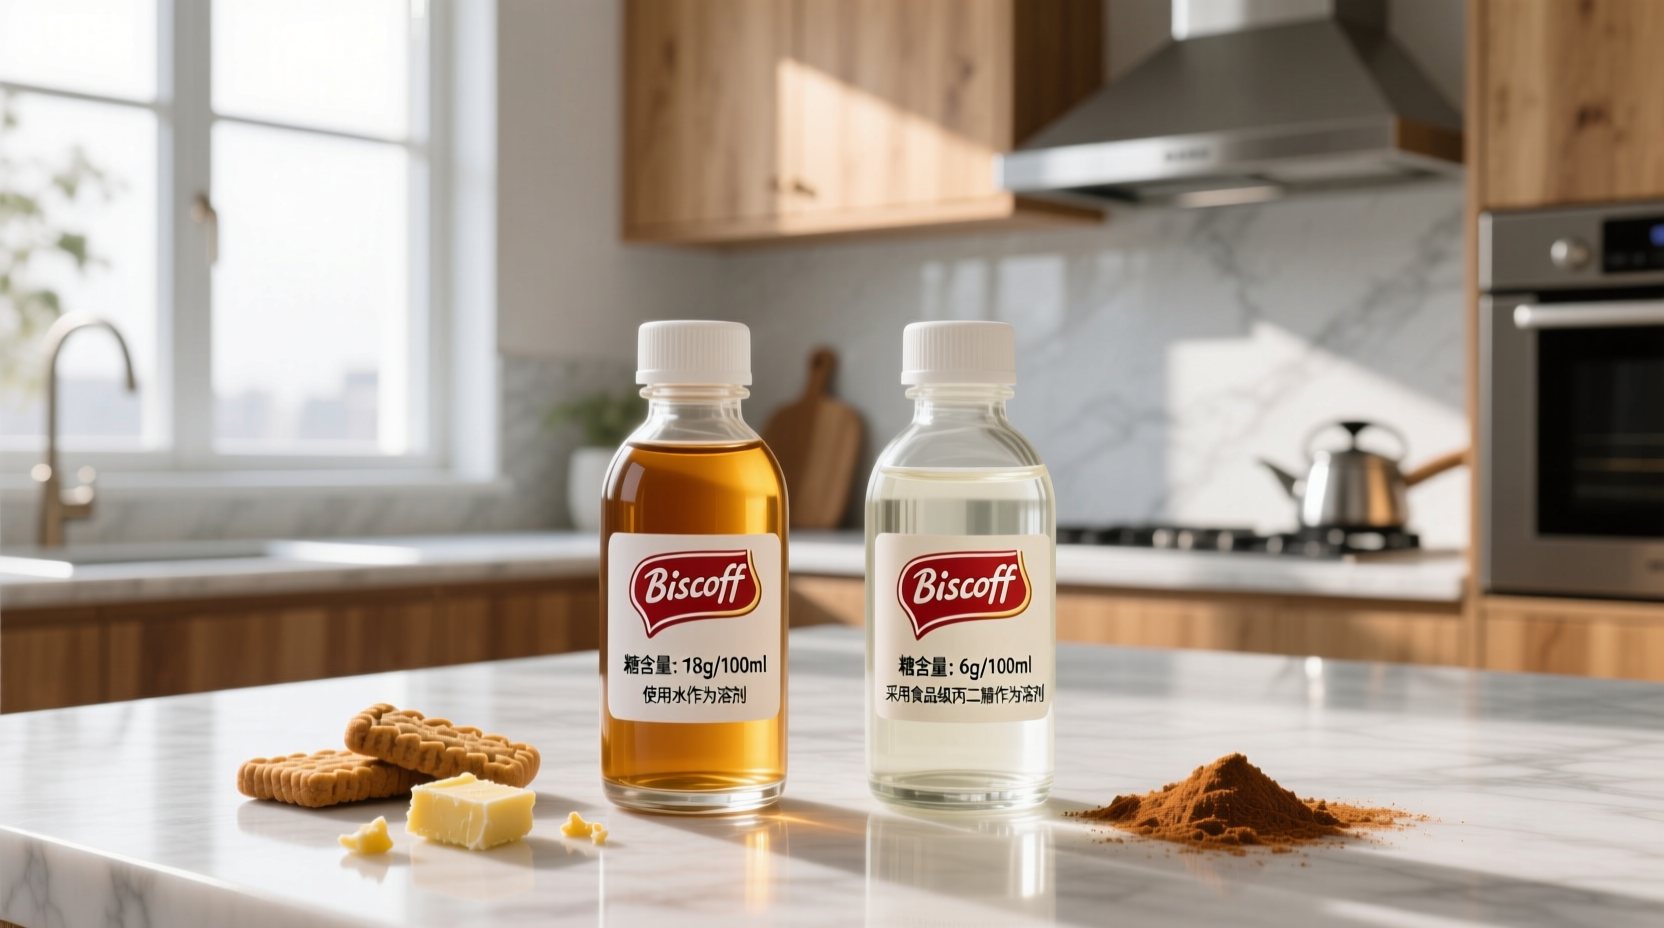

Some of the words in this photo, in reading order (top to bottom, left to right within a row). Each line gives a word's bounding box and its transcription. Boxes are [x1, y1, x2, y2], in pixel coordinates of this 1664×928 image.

[644, 563, 747, 604] Biscoff
[913, 563, 1018, 605] Biscoff
[682, 655, 767, 679] 18g/100ml
[959, 655, 1032, 680] 6g/100ml
[643, 685, 747, 704] 使用水作为溶剂
